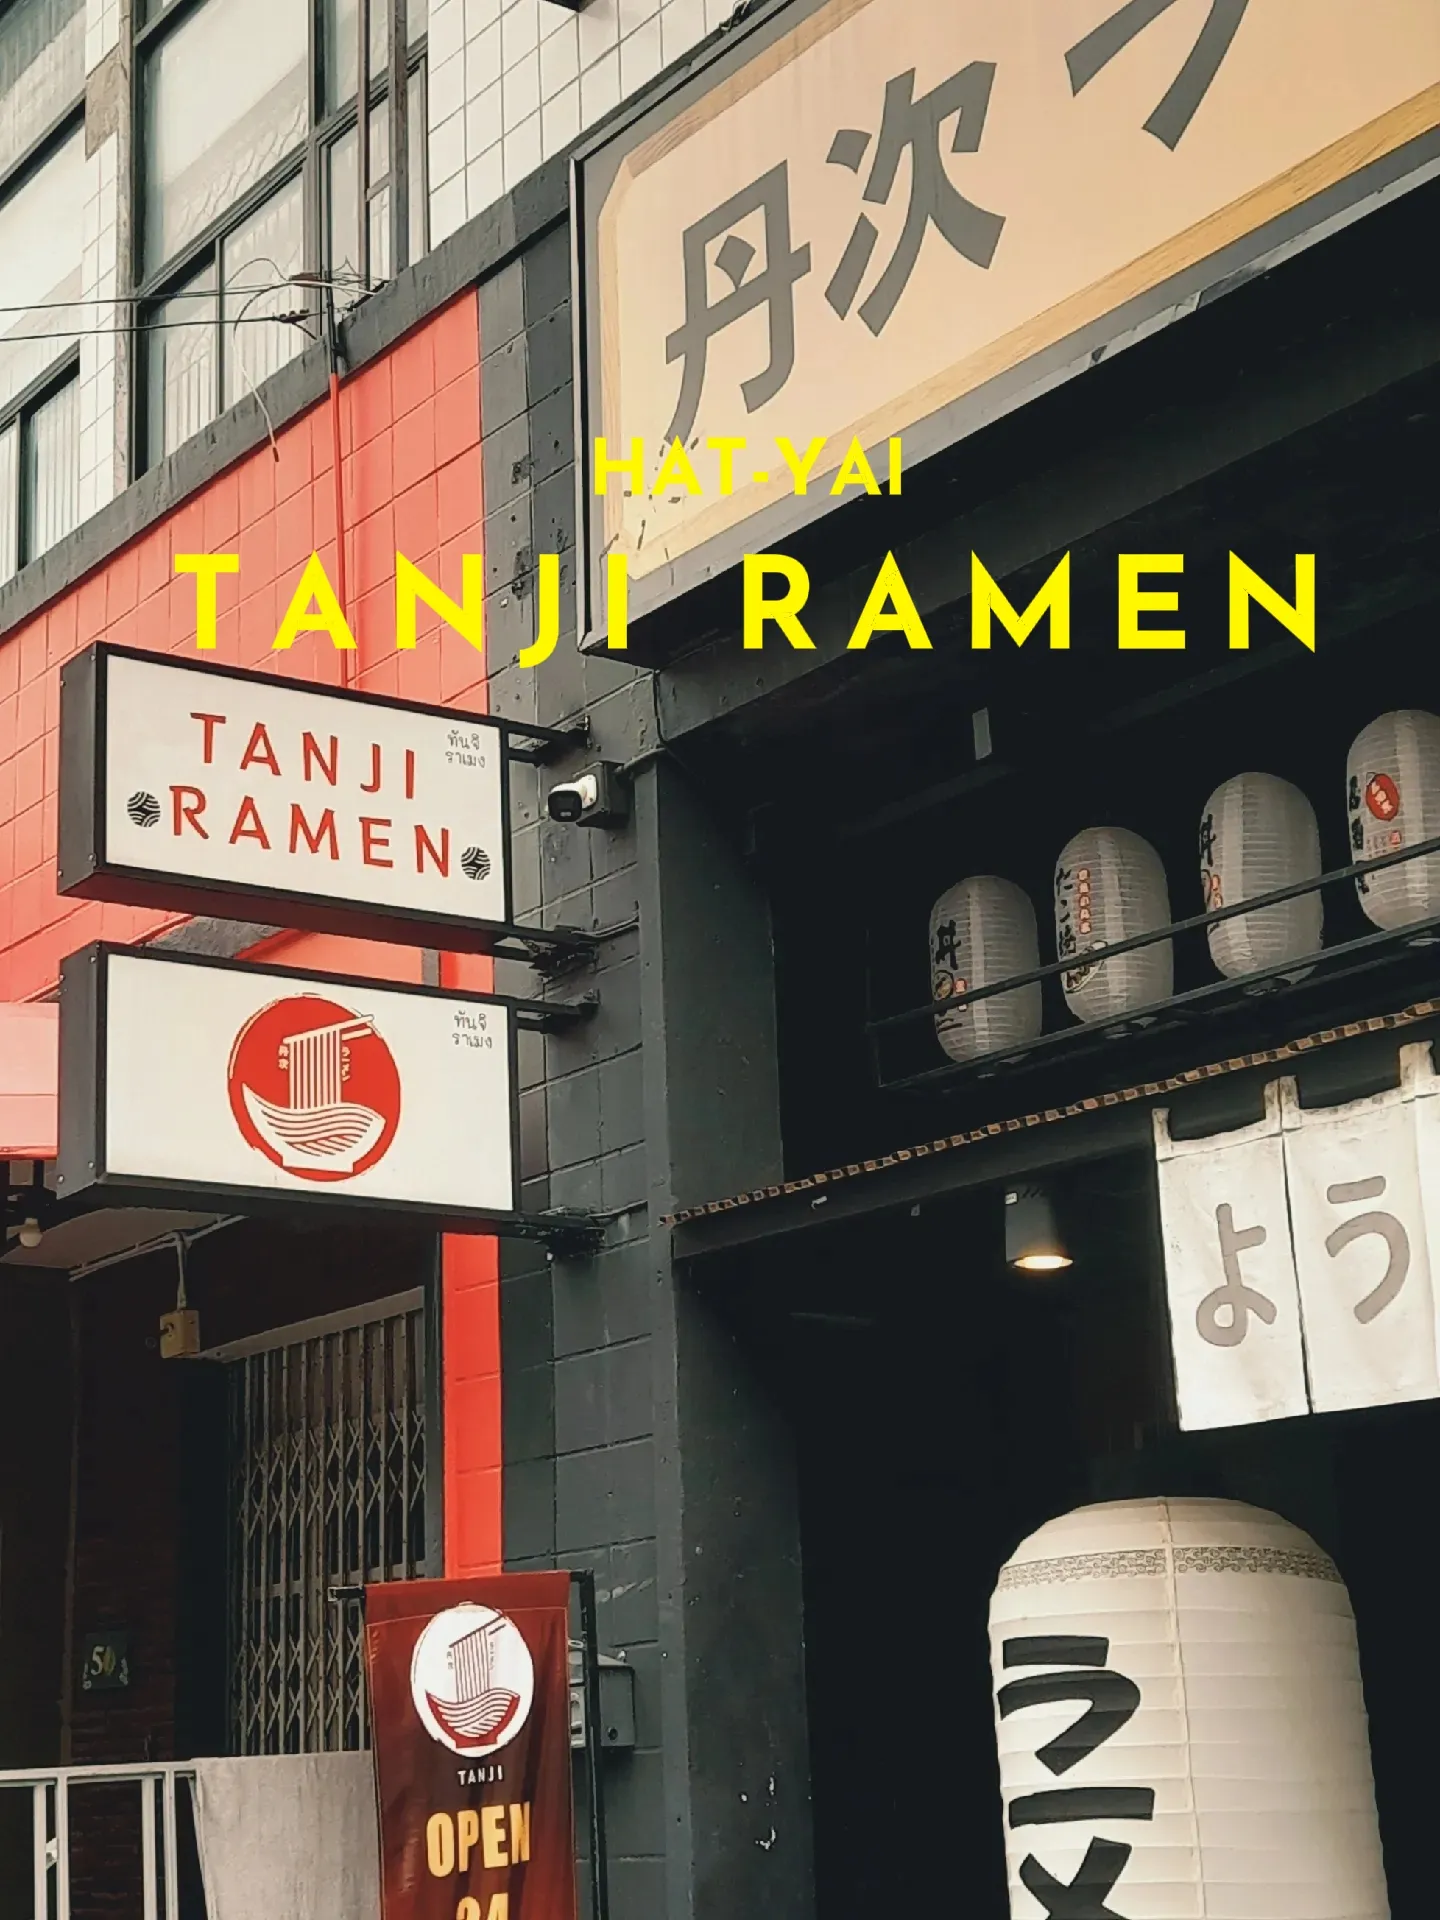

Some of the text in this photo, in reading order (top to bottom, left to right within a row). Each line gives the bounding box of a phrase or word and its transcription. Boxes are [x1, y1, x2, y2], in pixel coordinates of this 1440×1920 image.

[191, 712, 416, 799] TANJI
[169, 784, 451, 879] RAMEN
[457, 1765, 504, 1786] TANJI
[426, 1801, 530, 1878] OPEN
